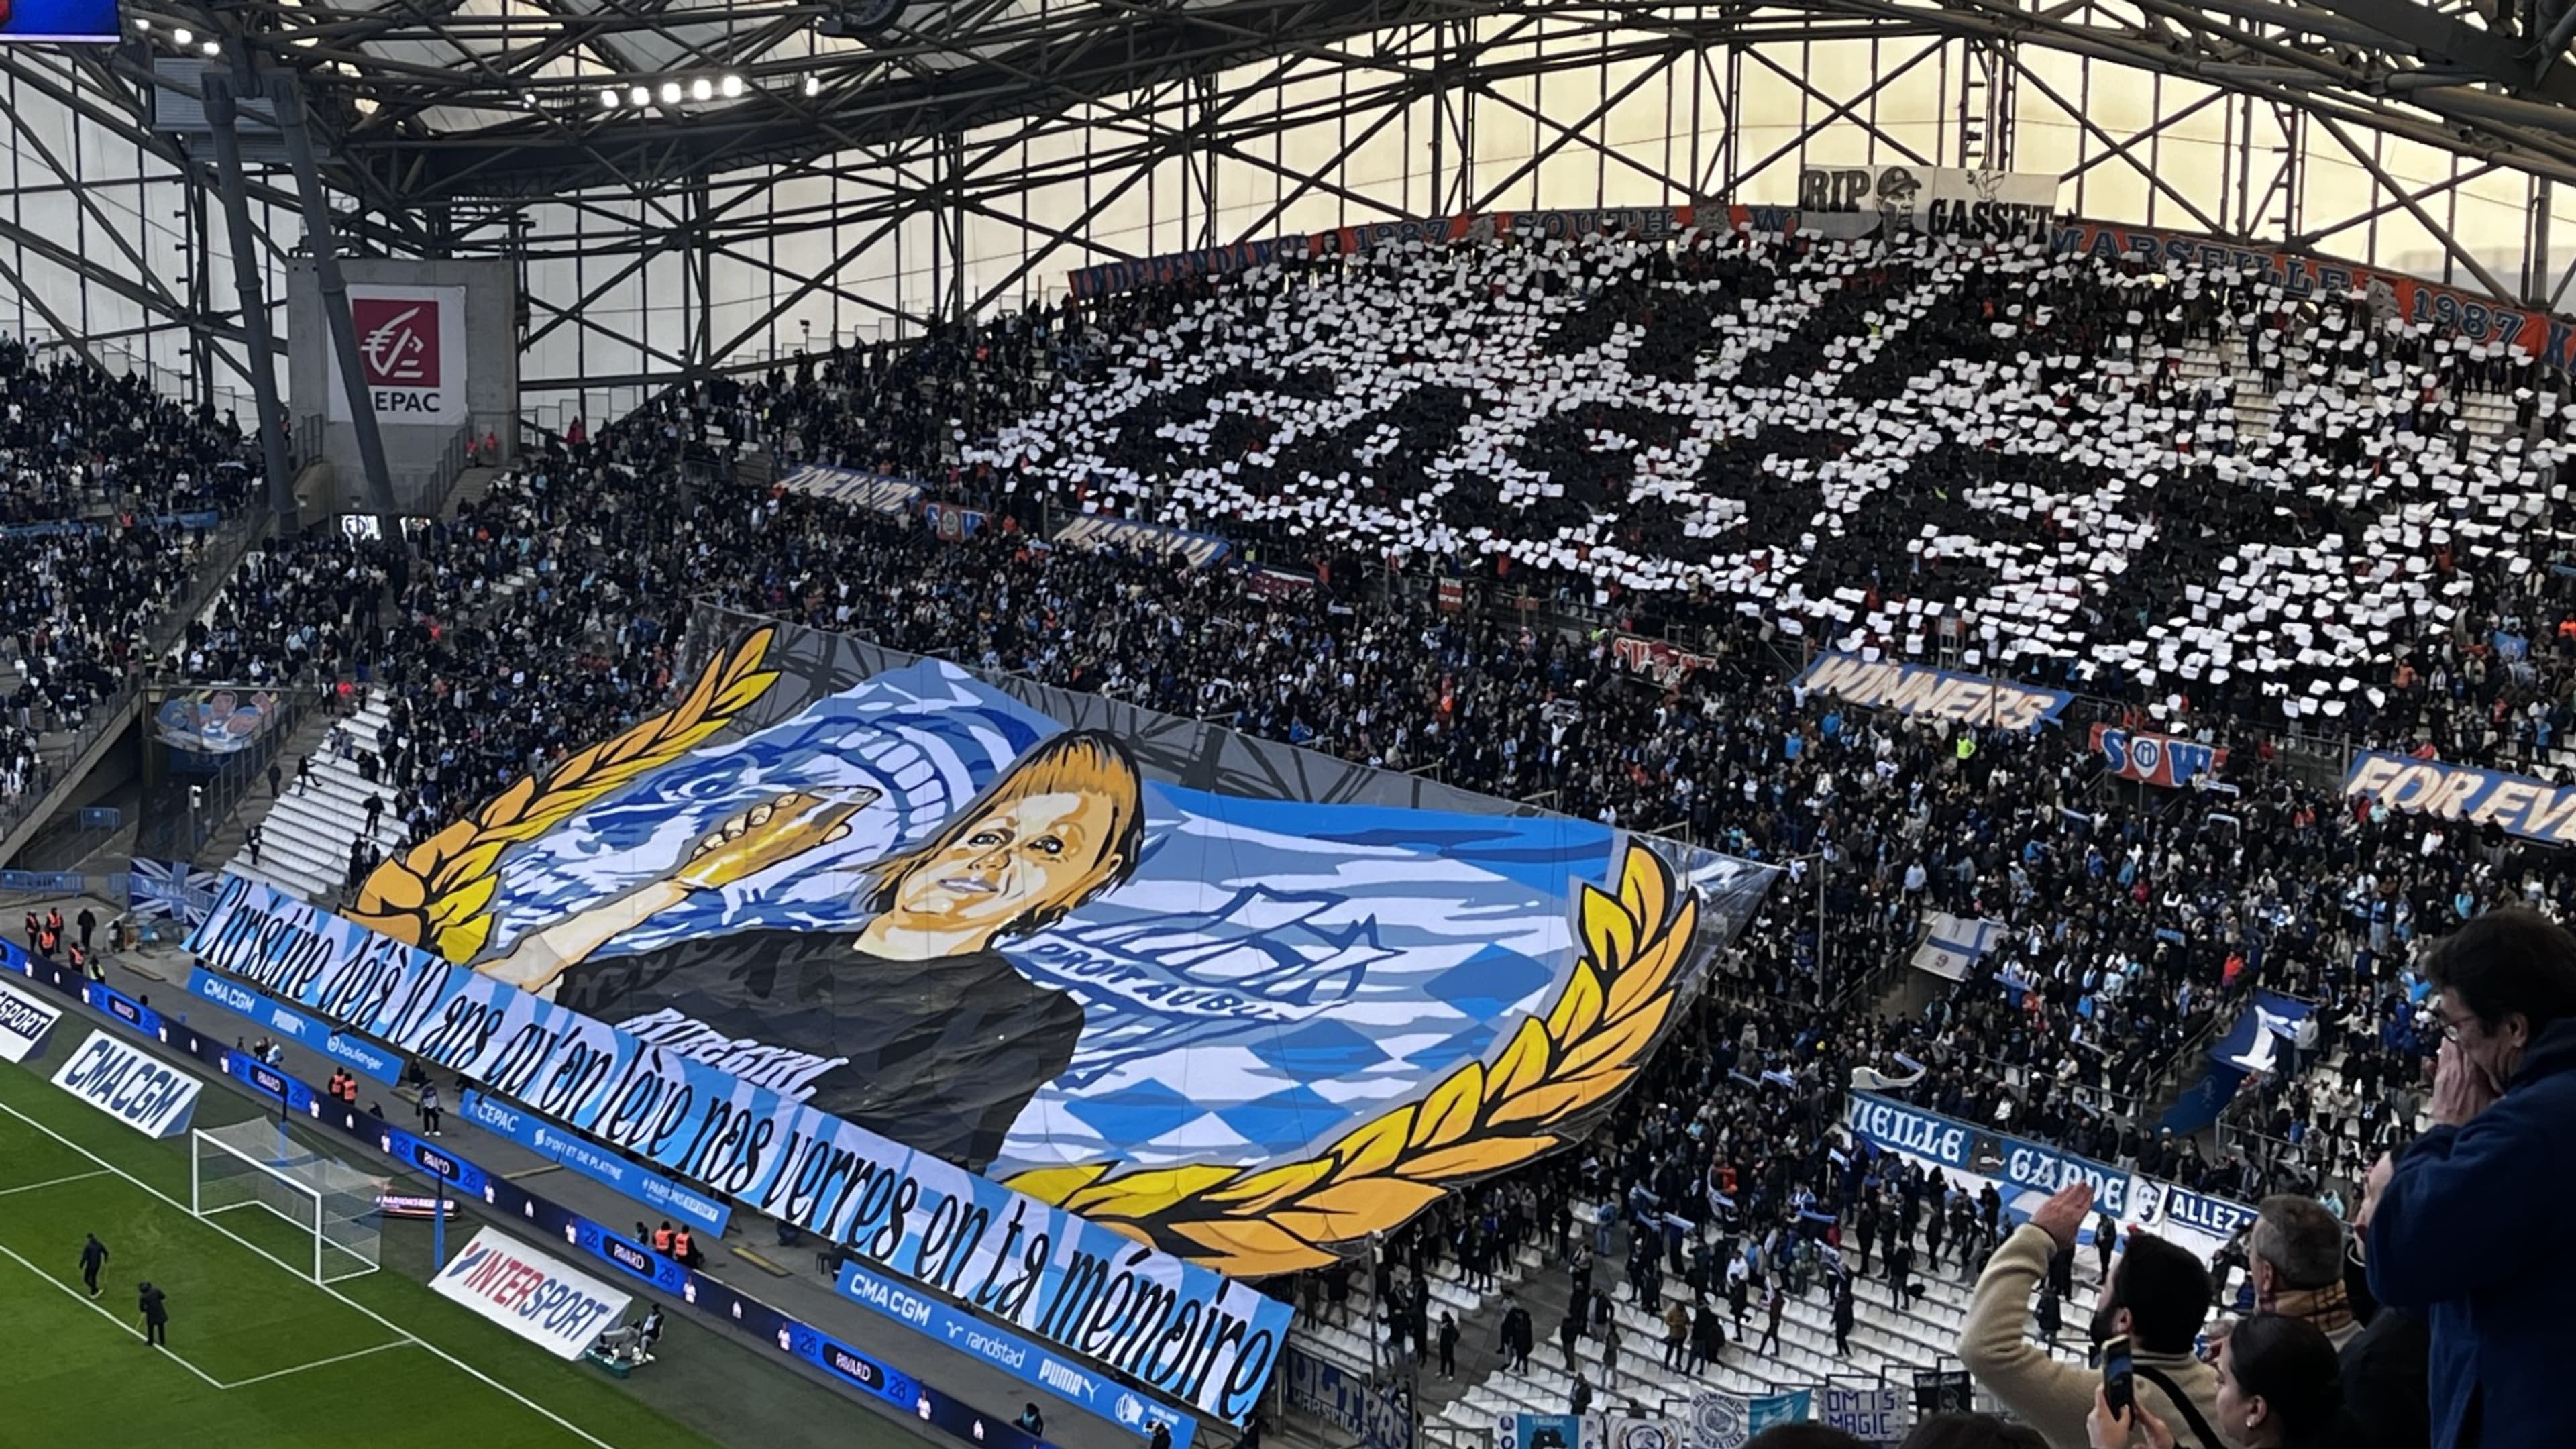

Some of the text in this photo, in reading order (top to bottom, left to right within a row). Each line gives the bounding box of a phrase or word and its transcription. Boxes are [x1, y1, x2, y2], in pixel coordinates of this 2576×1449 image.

[1799, 169, 1871, 213] RIP
[1355, 219, 1453, 254] 1987
[1511, 207, 1674, 240] SOUTH
[1929, 199, 2053, 244] GASSET
[2050, 226, 2526, 344] MARSEILLE 1987
[376, 391, 441, 413] EPAC
[1805, 655, 2057, 730] WINNERS
[1034, 943, 1148, 983] DROIT
[477, 1104, 519, 1134] CEPAC
[1847, 1096, 1966, 1163] VIEILLE
[189, 876, 334, 1000] Christine
[417, 994, 504, 1071] ans
[678, 1096, 774, 1194] nos
[762, 1130, 918, 1261] verres
[914, 1194, 990, 1291] en
[980, 1199, 1049, 1320] ta
[1035, 1247, 1273, 1419] mémoire
[2171, 1193, 2240, 1228] ALLEZ
[463, 1250, 611, 1342] INTERSPORT
[965, 1329, 1026, 1369] randstad
[1038, 1358, 1084, 1396] PUMA
[1827, 1390, 1860, 1412] OM
[1829, 1413, 1892, 1435] MAGIC
